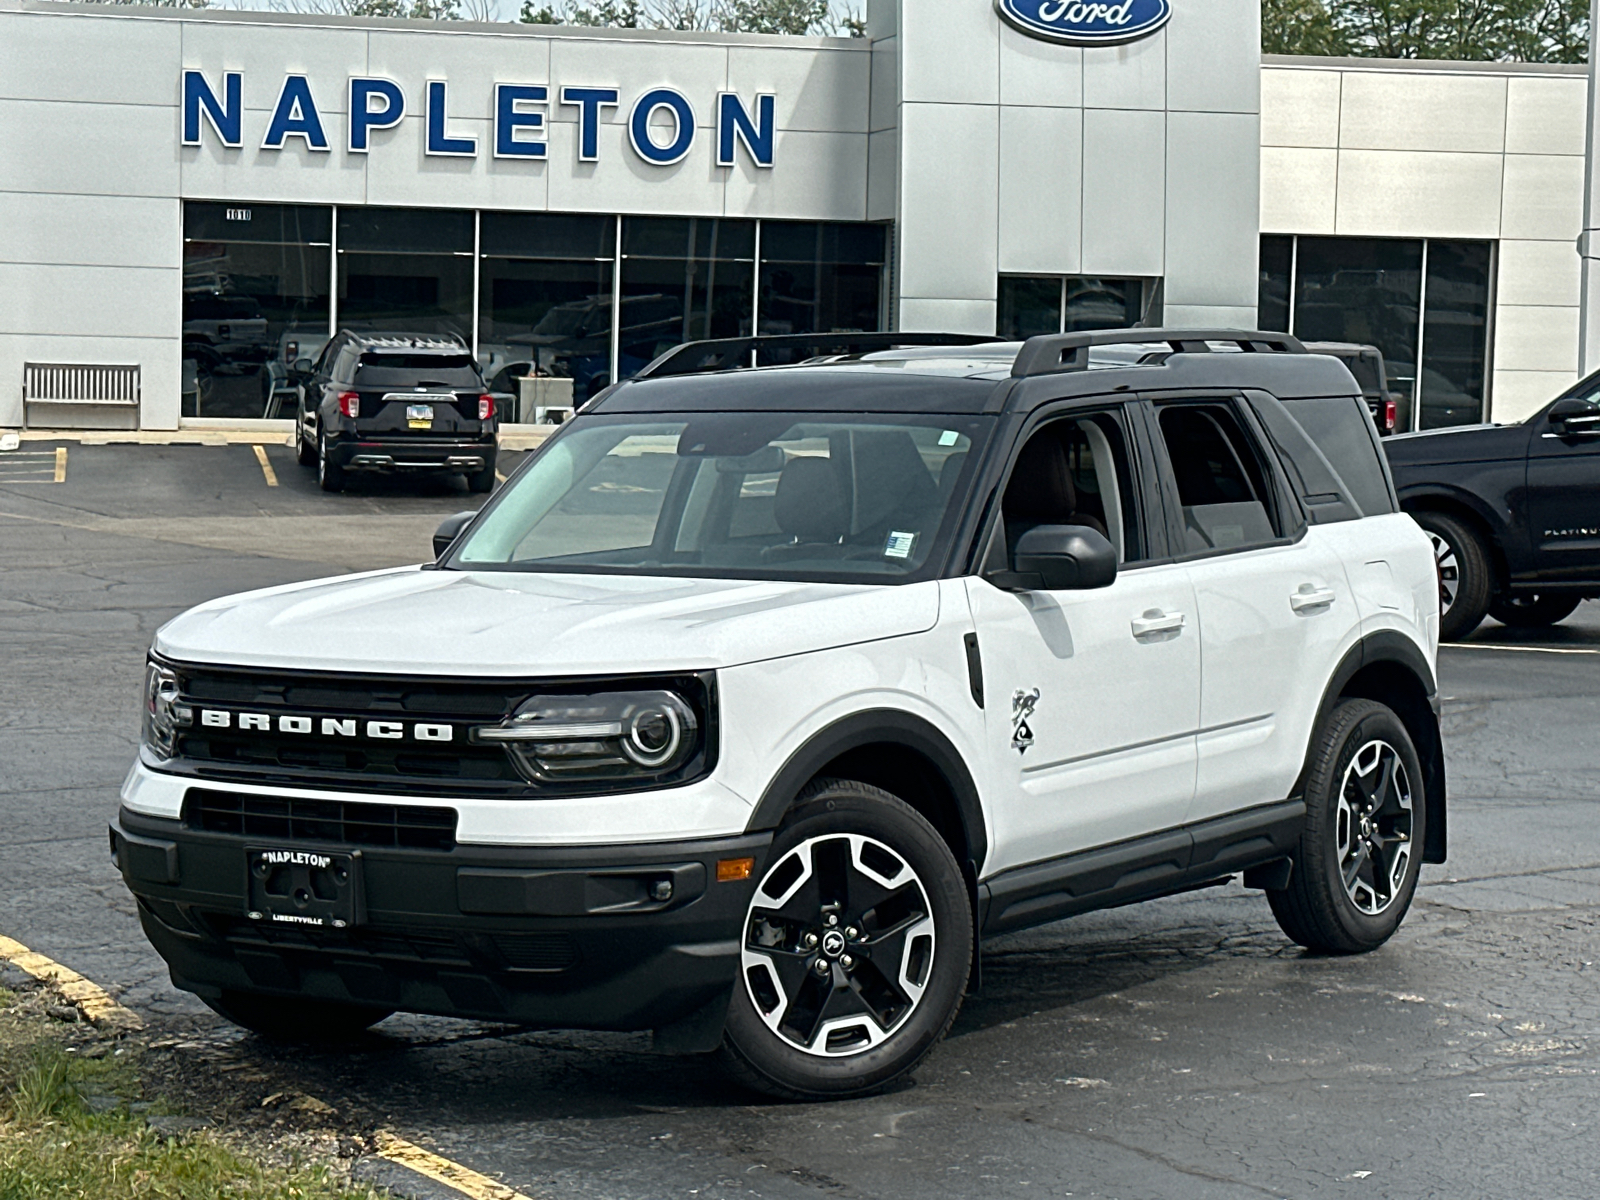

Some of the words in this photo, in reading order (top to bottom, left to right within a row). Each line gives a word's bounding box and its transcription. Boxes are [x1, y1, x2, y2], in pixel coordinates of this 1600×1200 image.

[180, 68, 777, 168] NAPLETON
[226, 208, 252, 221] 1010
[1544, 527, 1600, 536] PLATINU
[201, 709, 453, 742] BRONCO
[267, 851, 327, 868] NAPLETON
[272, 913, 323, 925] LIBERTYVILLE
